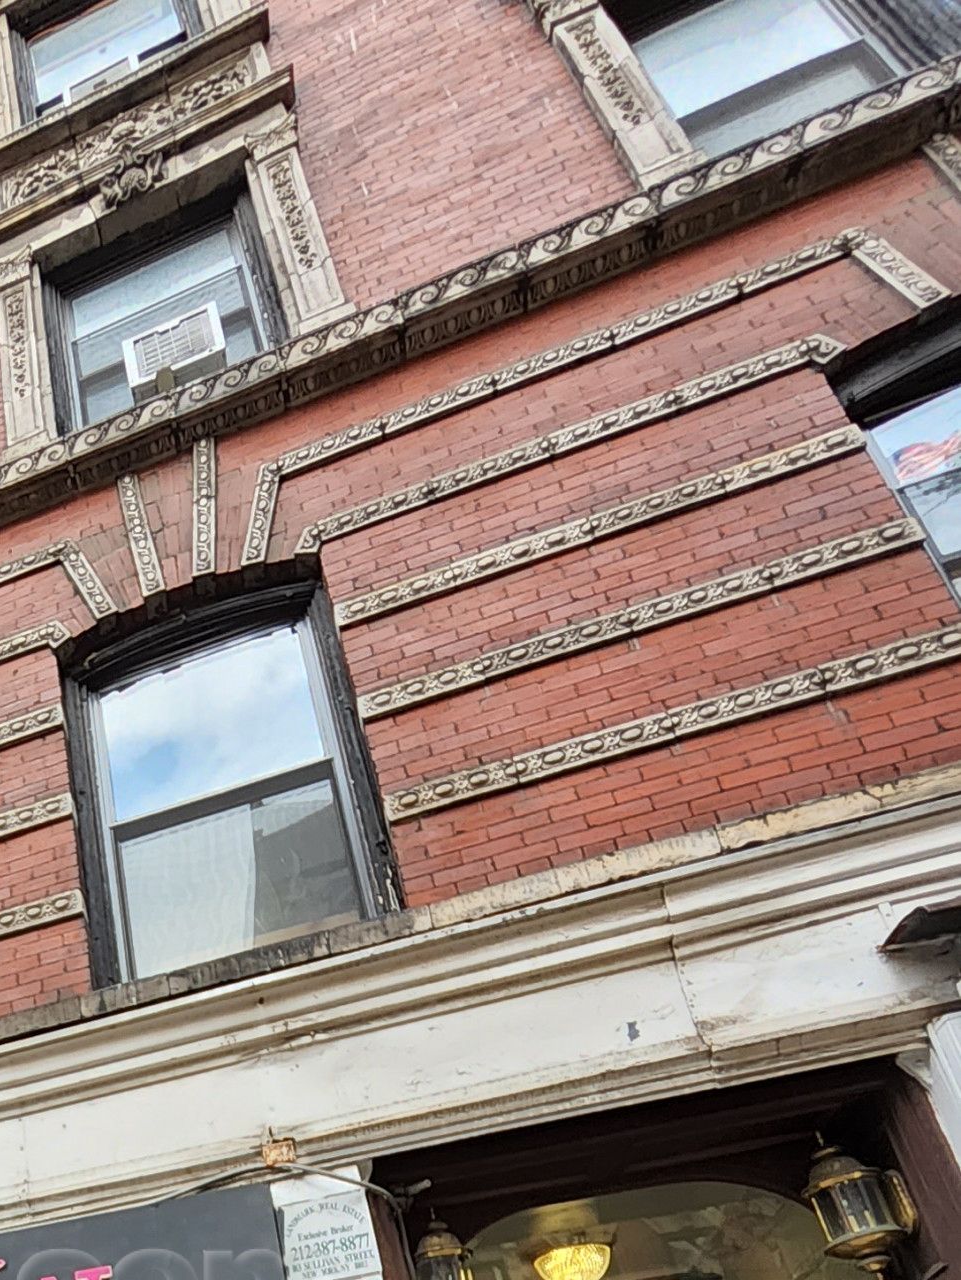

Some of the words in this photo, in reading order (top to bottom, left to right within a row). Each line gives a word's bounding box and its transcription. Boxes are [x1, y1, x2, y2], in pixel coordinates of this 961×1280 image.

[319, 1203, 338, 1212] REAL
[343, 1205, 365, 1223] ESTATE
[330, 1224, 353, 1235] Broker
